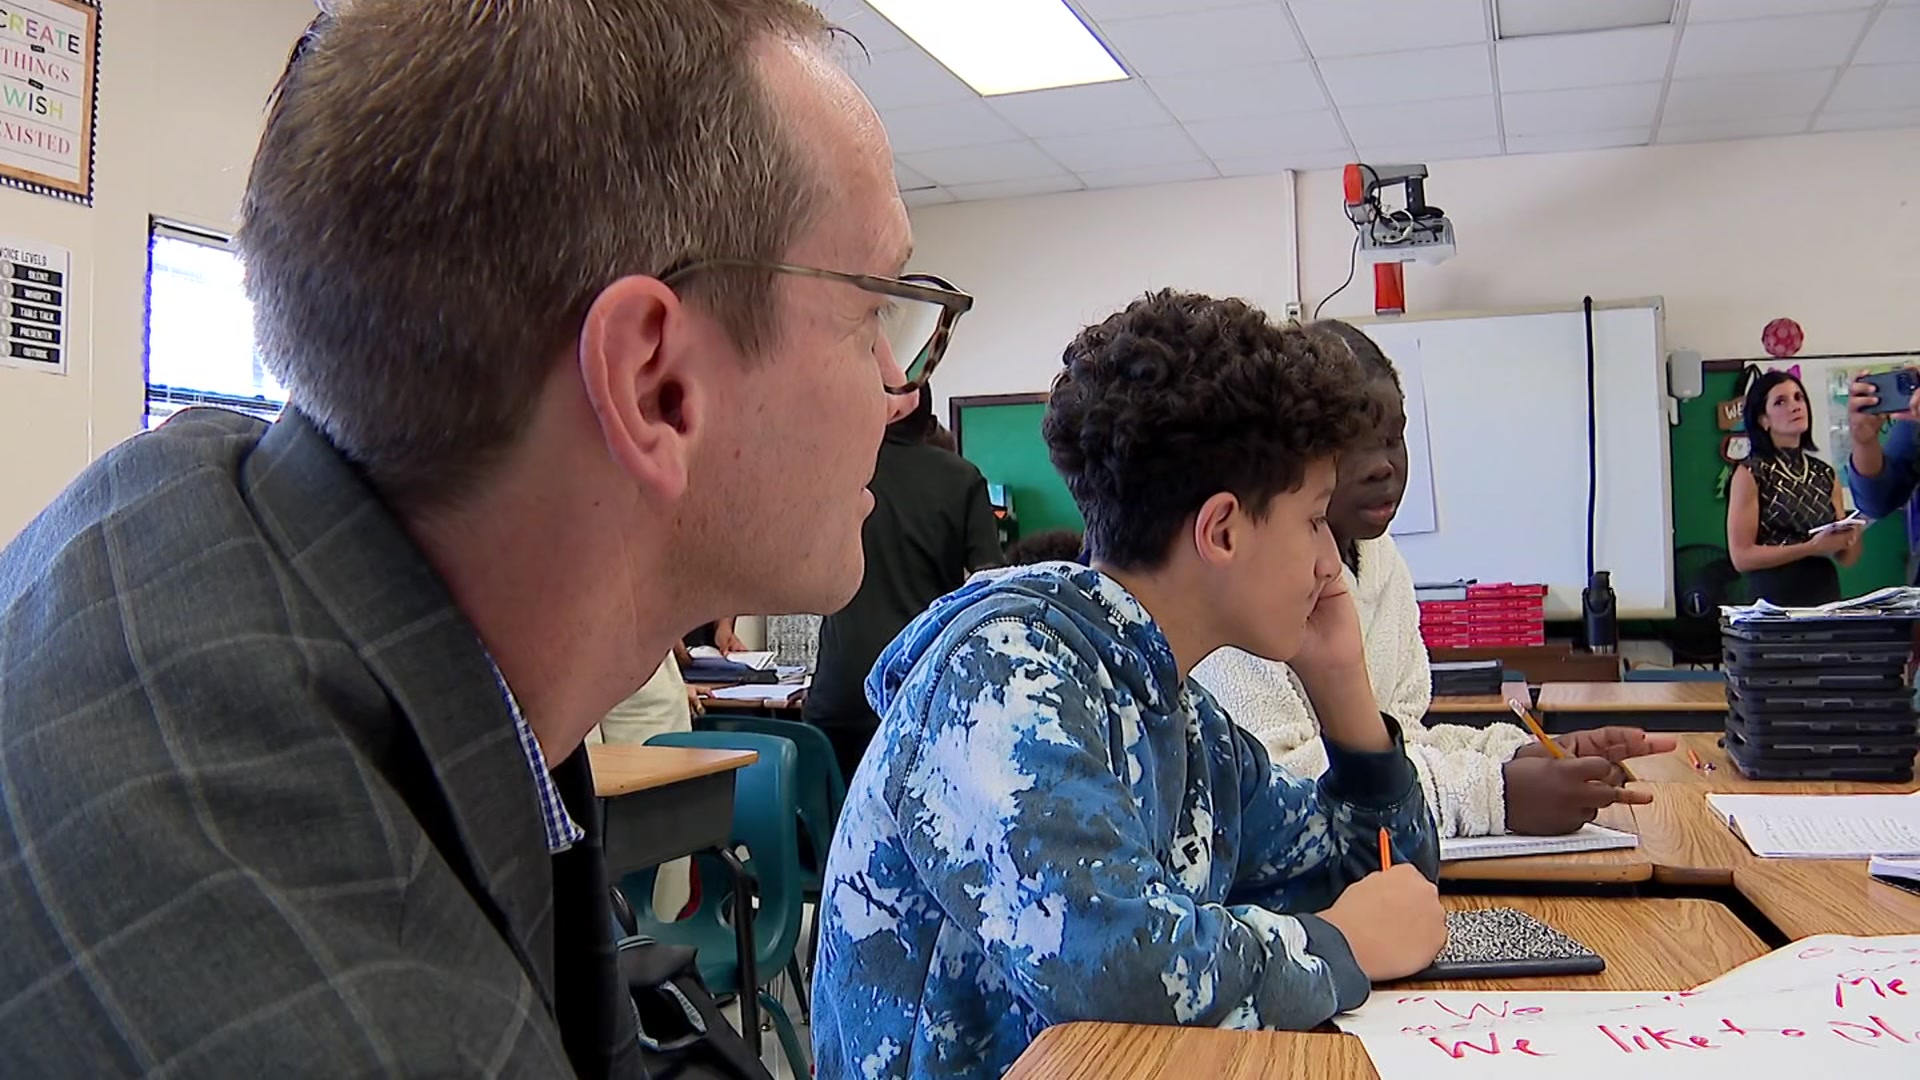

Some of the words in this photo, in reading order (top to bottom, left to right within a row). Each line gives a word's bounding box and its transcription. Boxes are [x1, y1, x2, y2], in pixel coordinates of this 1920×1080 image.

[0, 47, 70, 83] THINGS
[3, 85, 64, 120] WISH
[0, 120, 71, 155] XISTED
[21, 250, 47, 267] LEVELS
[1428, 1031, 1556, 1059] We
